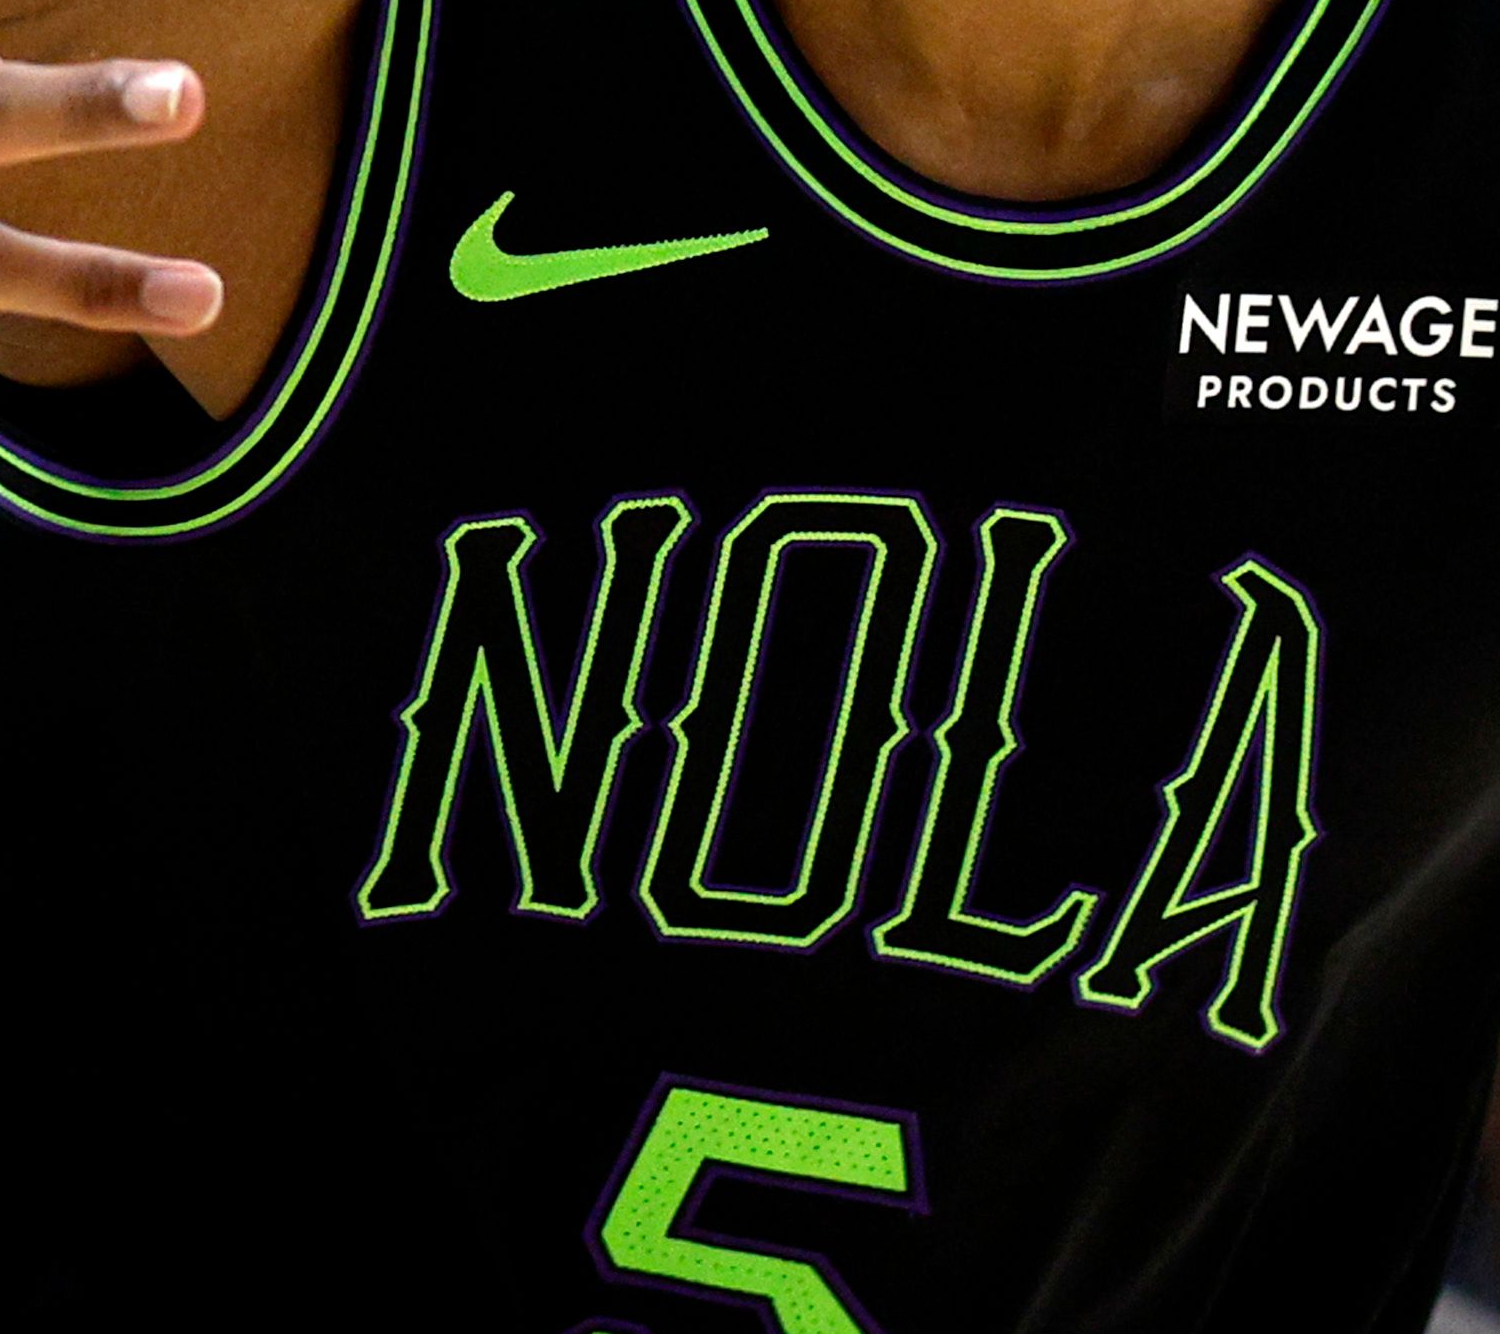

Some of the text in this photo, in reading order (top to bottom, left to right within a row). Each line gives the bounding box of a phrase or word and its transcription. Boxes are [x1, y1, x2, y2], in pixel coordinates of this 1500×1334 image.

[1178, 293, 1499, 359] NEWAGE
[1196, 374, 1457, 413] PRODUCTS
[354, 489, 1324, 1053] NOLA
